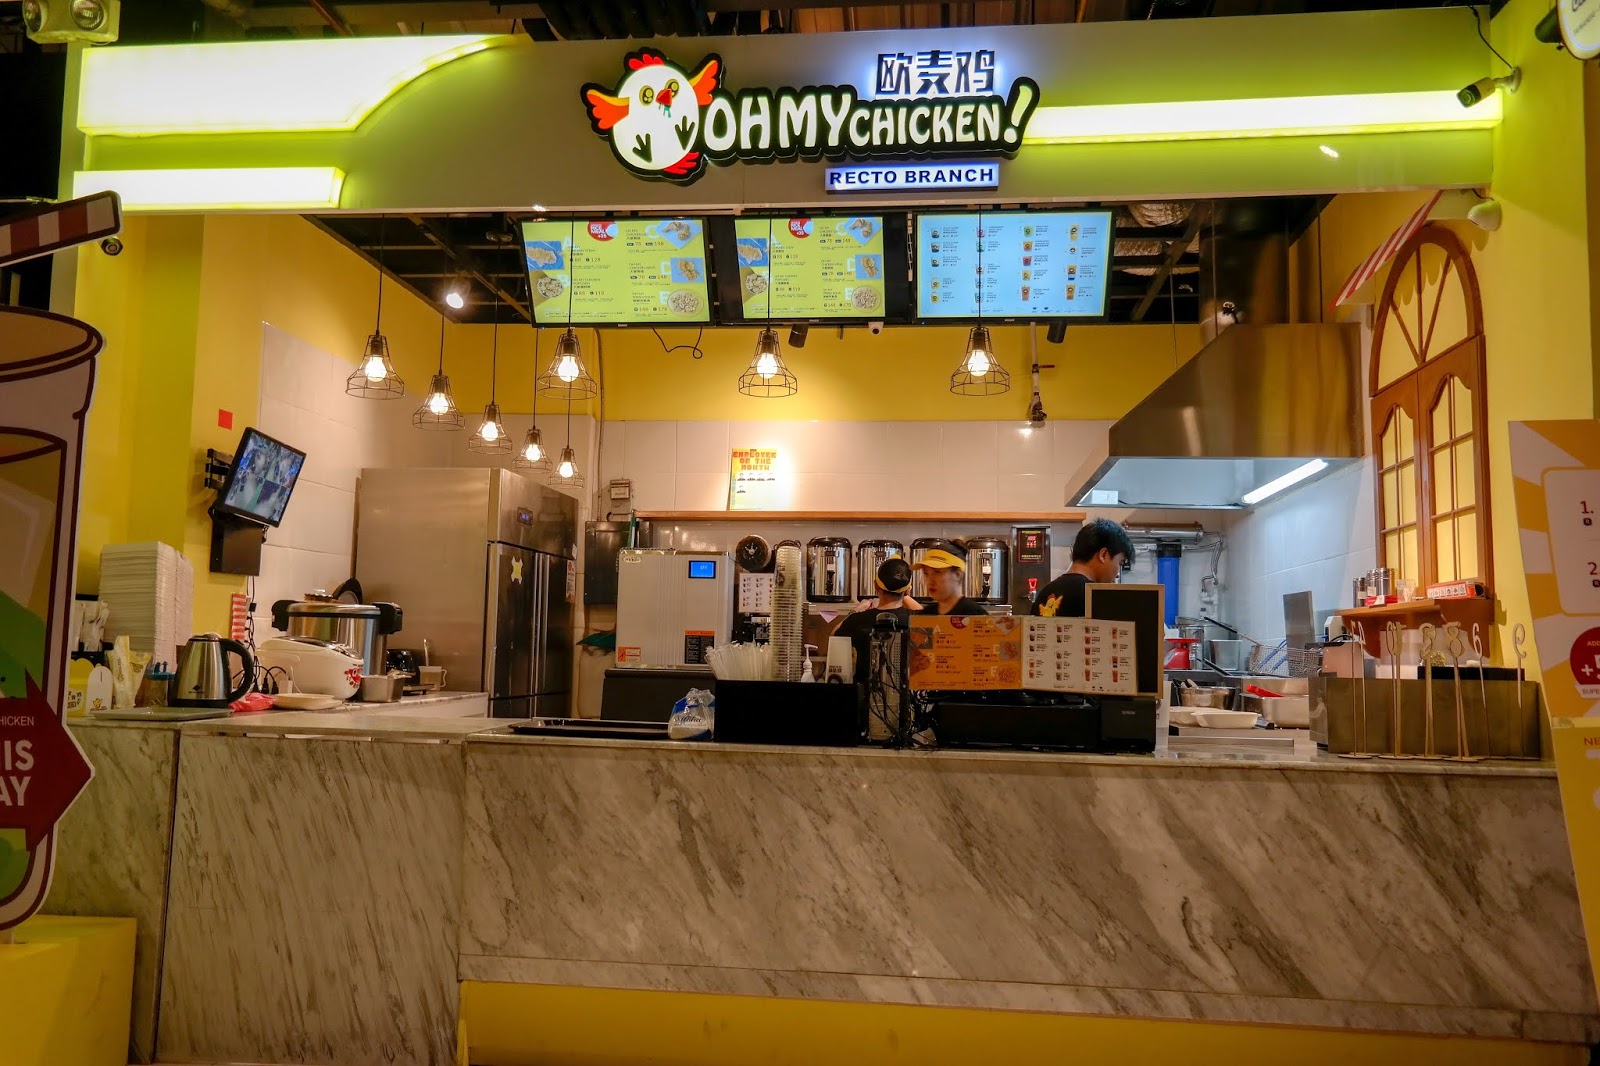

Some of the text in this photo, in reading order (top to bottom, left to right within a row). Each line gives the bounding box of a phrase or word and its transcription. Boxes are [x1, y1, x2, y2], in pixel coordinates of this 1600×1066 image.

[876, 50, 995, 96] 欧麦鸡
[829, 168, 994, 185] RECTO BRANCH
